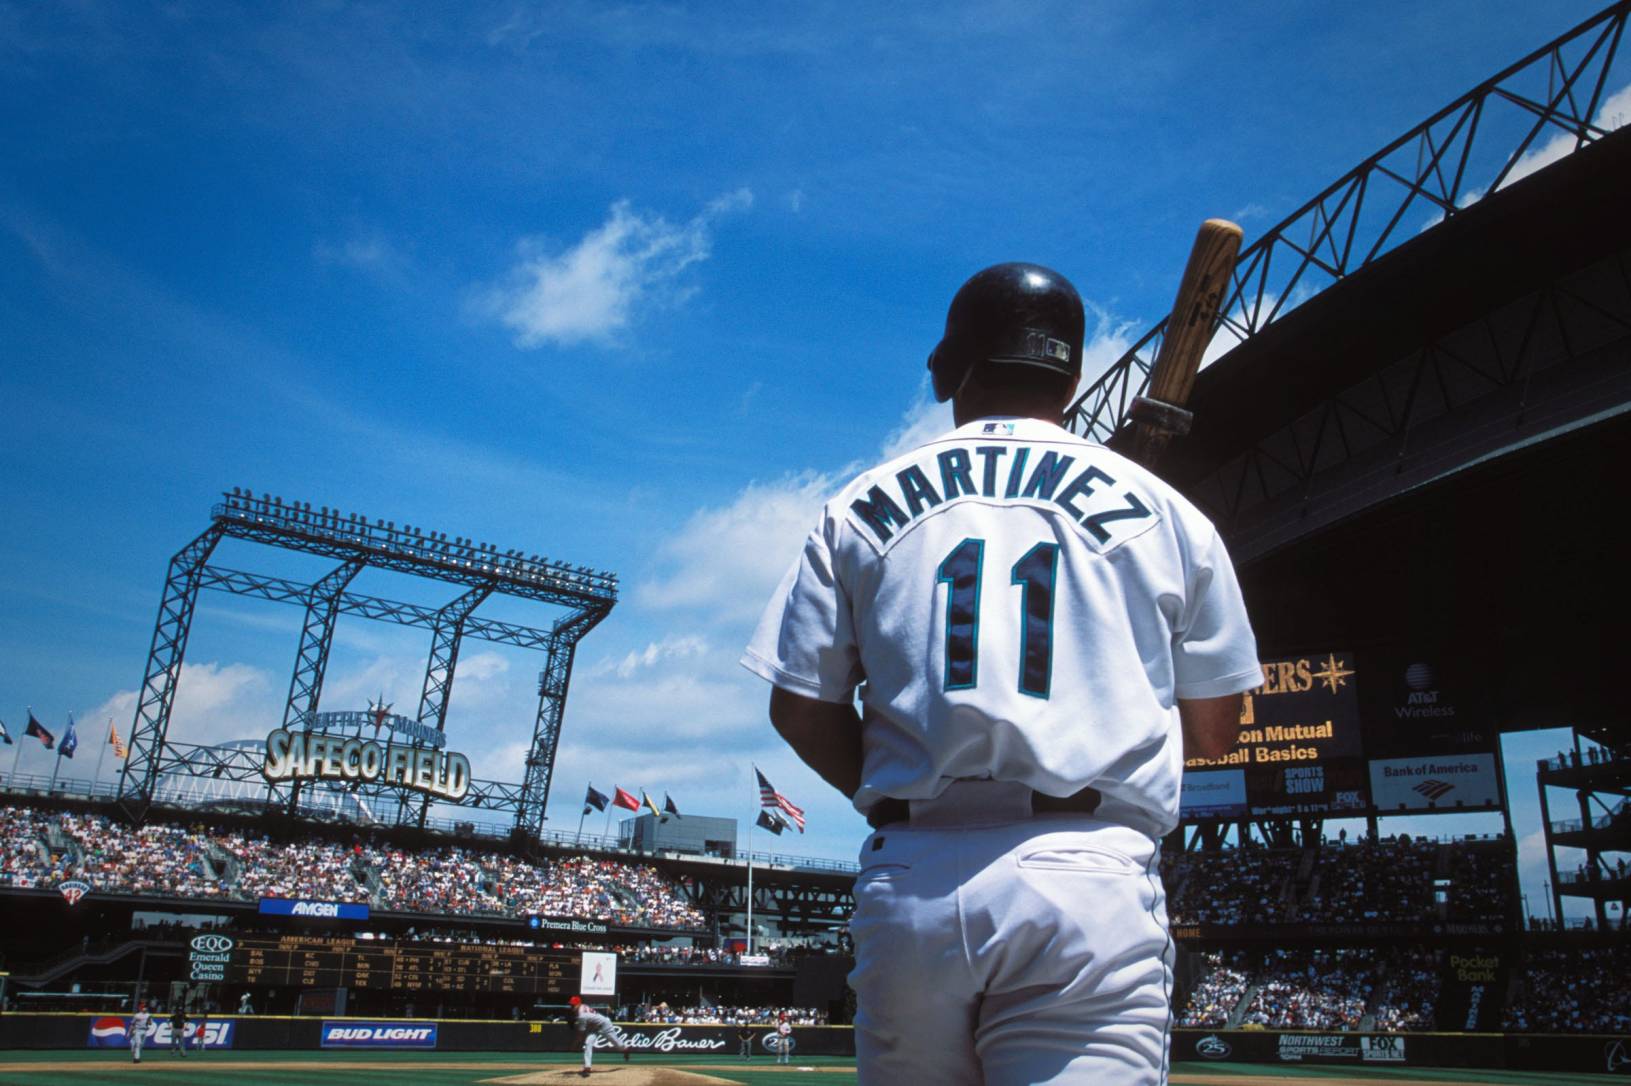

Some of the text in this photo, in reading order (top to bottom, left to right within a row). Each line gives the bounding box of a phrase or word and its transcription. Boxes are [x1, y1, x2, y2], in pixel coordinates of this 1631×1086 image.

[850, 445, 1153, 545] MARTINEZ
[937, 537, 1060, 700] 11
[1246, 659, 1313, 695] ERS
[1407, 690, 1440, 705] AT&T
[1393, 705, 1456, 719] Wireless
[1237, 720, 1333, 744] on Mutual
[1255, 745, 1319, 763] Basics
[265, 729, 471, 802] SAFECO FIELD
[1384, 761, 1478, 777] Bank of America
[1286, 778, 1325, 794] SHOW
[291, 901, 339, 917] AMGEN
[541, 918, 607, 933] Premera Blue Cross
[192, 935, 233, 952] EQC
[280, 935, 323, 946] AMERICAN
[190, 952, 230, 963] Emerald
[1450, 954, 1499, 969] Pocket
[192, 962, 224, 971] Queen
[190, 971, 225, 981] Casino
[1457, 968, 1497, 982] Bank
[327, 1028, 433, 1041] BUD LIGHT
[654, 1027, 726, 1052] Bauer
[1279, 1034, 1345, 1047] NORTHWEST
[1369, 1036, 1398, 1050] FOX
